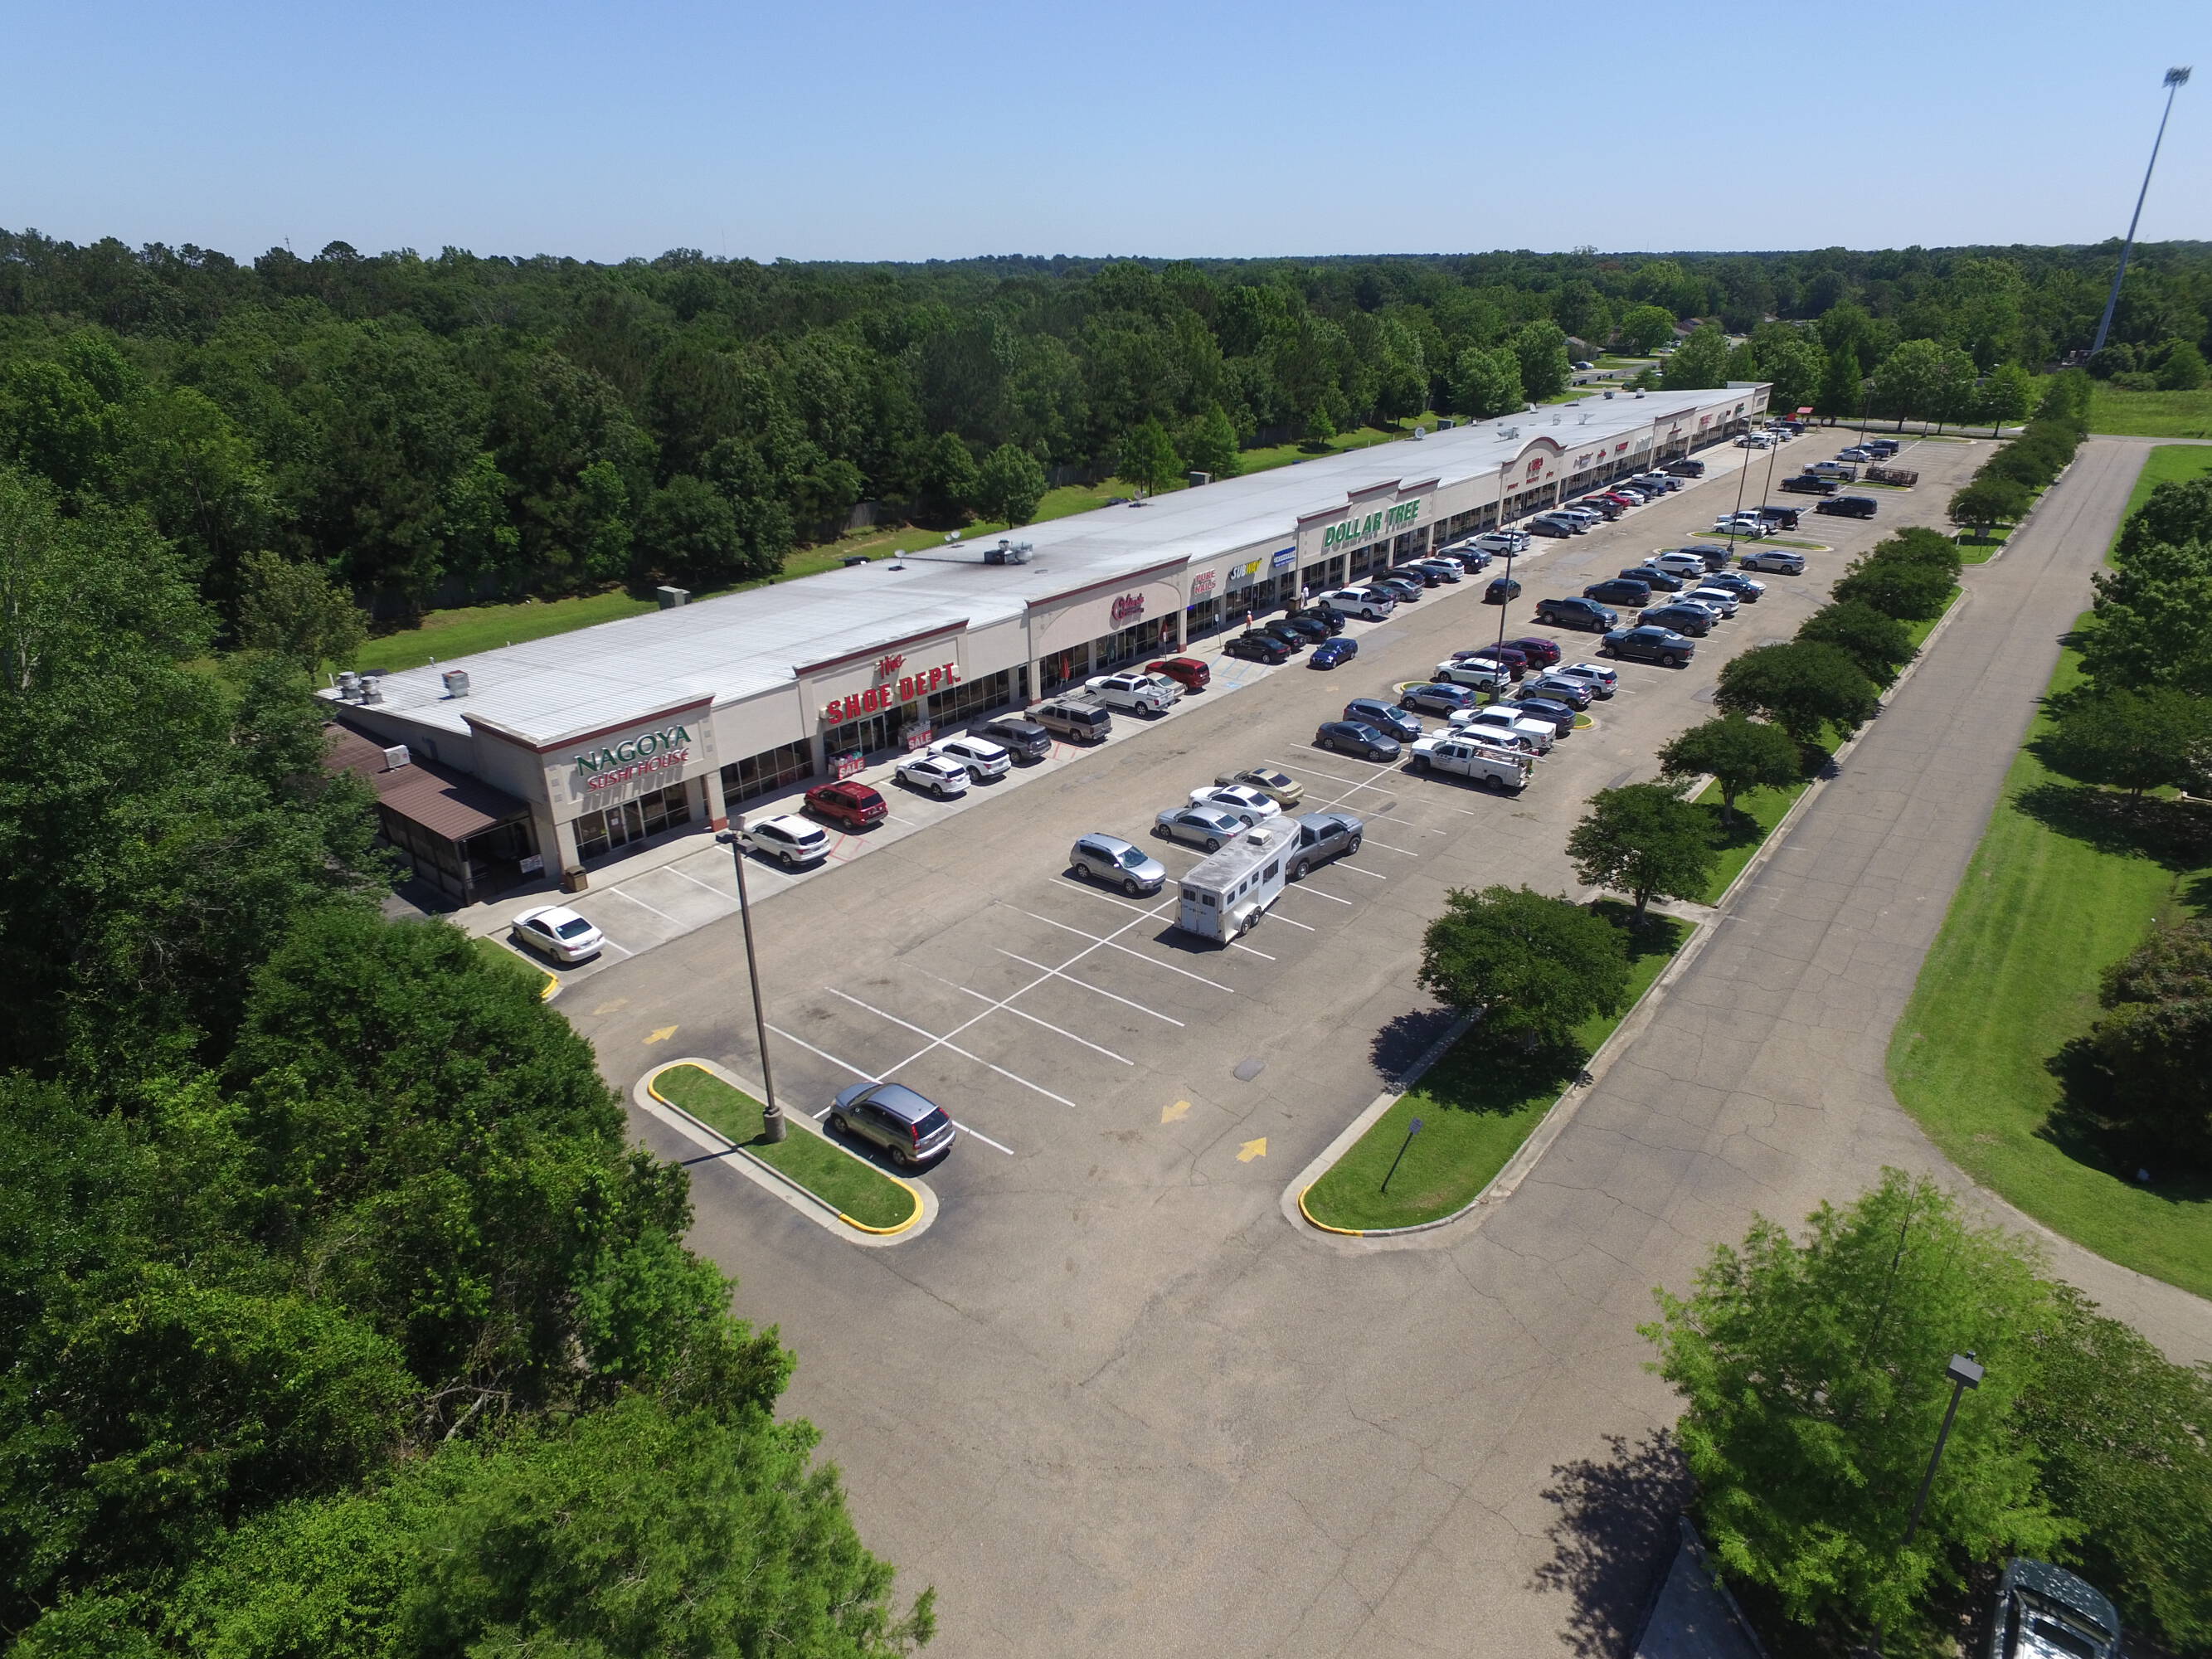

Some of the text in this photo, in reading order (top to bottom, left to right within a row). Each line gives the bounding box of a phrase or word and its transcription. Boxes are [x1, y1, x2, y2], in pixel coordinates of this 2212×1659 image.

[1325, 499, 1421, 547] DOLLAR TREE
[1229, 557, 1262, 580] SUBWAY
[826, 662, 961, 724] SHOE DEPT.
[574, 724, 692, 776] NAGOYA
[907, 732, 932, 751] SALE
[586, 747, 689, 792] SUSHI HOUSE
[839, 761, 864, 779] SALE
